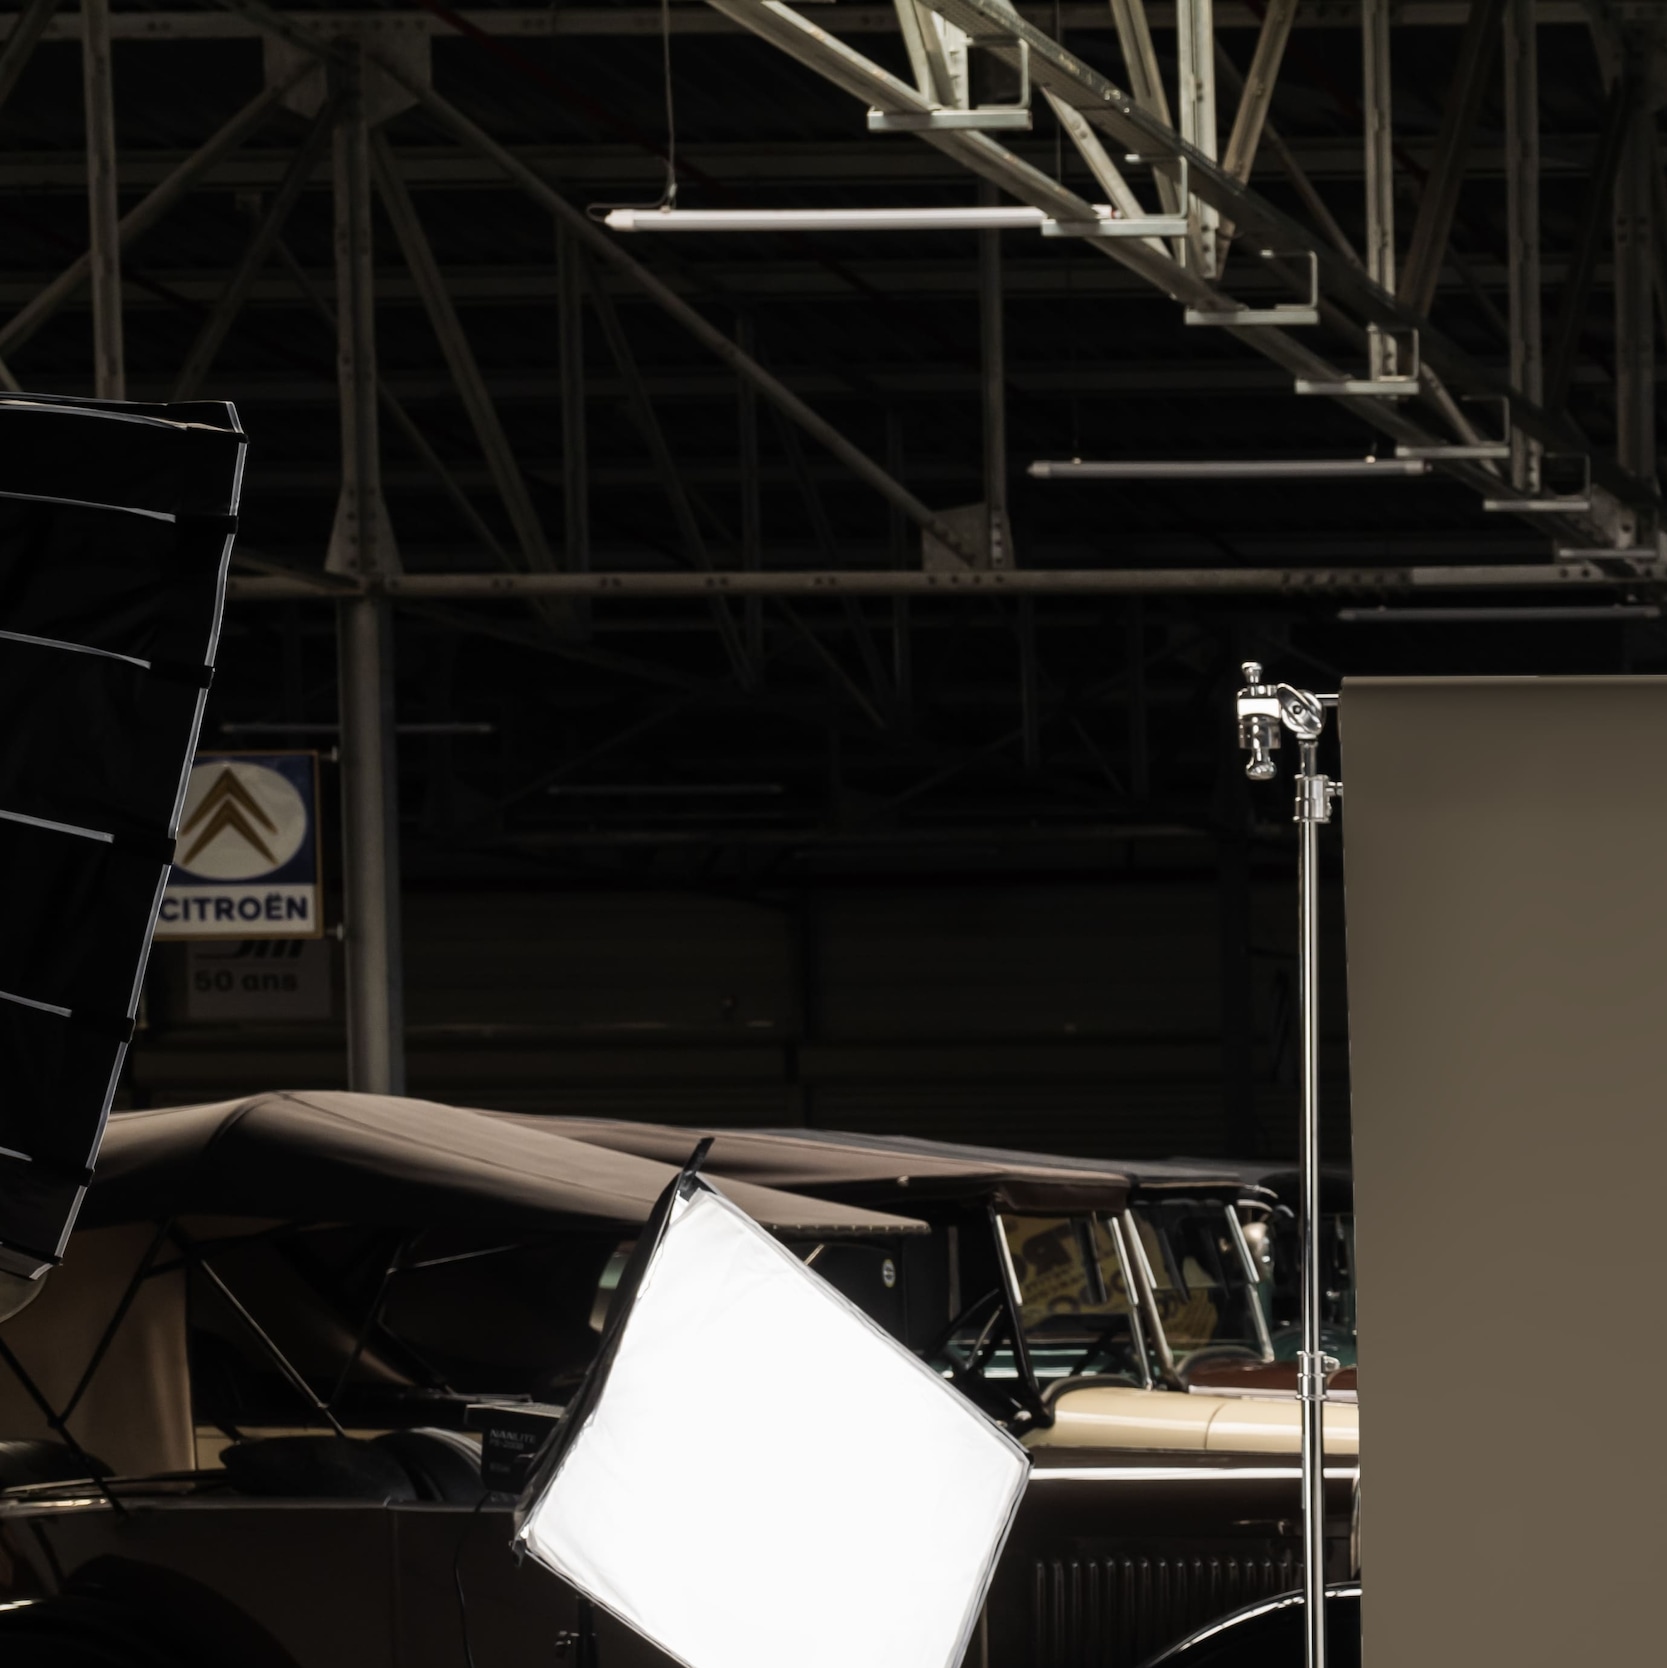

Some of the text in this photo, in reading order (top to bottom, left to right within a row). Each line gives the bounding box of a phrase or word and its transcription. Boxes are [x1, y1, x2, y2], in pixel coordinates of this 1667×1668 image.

[159, 892, 308, 922] CITROËN
[194, 970, 298, 992] 50 ans
[489, 1428, 537, 1444] NANLITE
